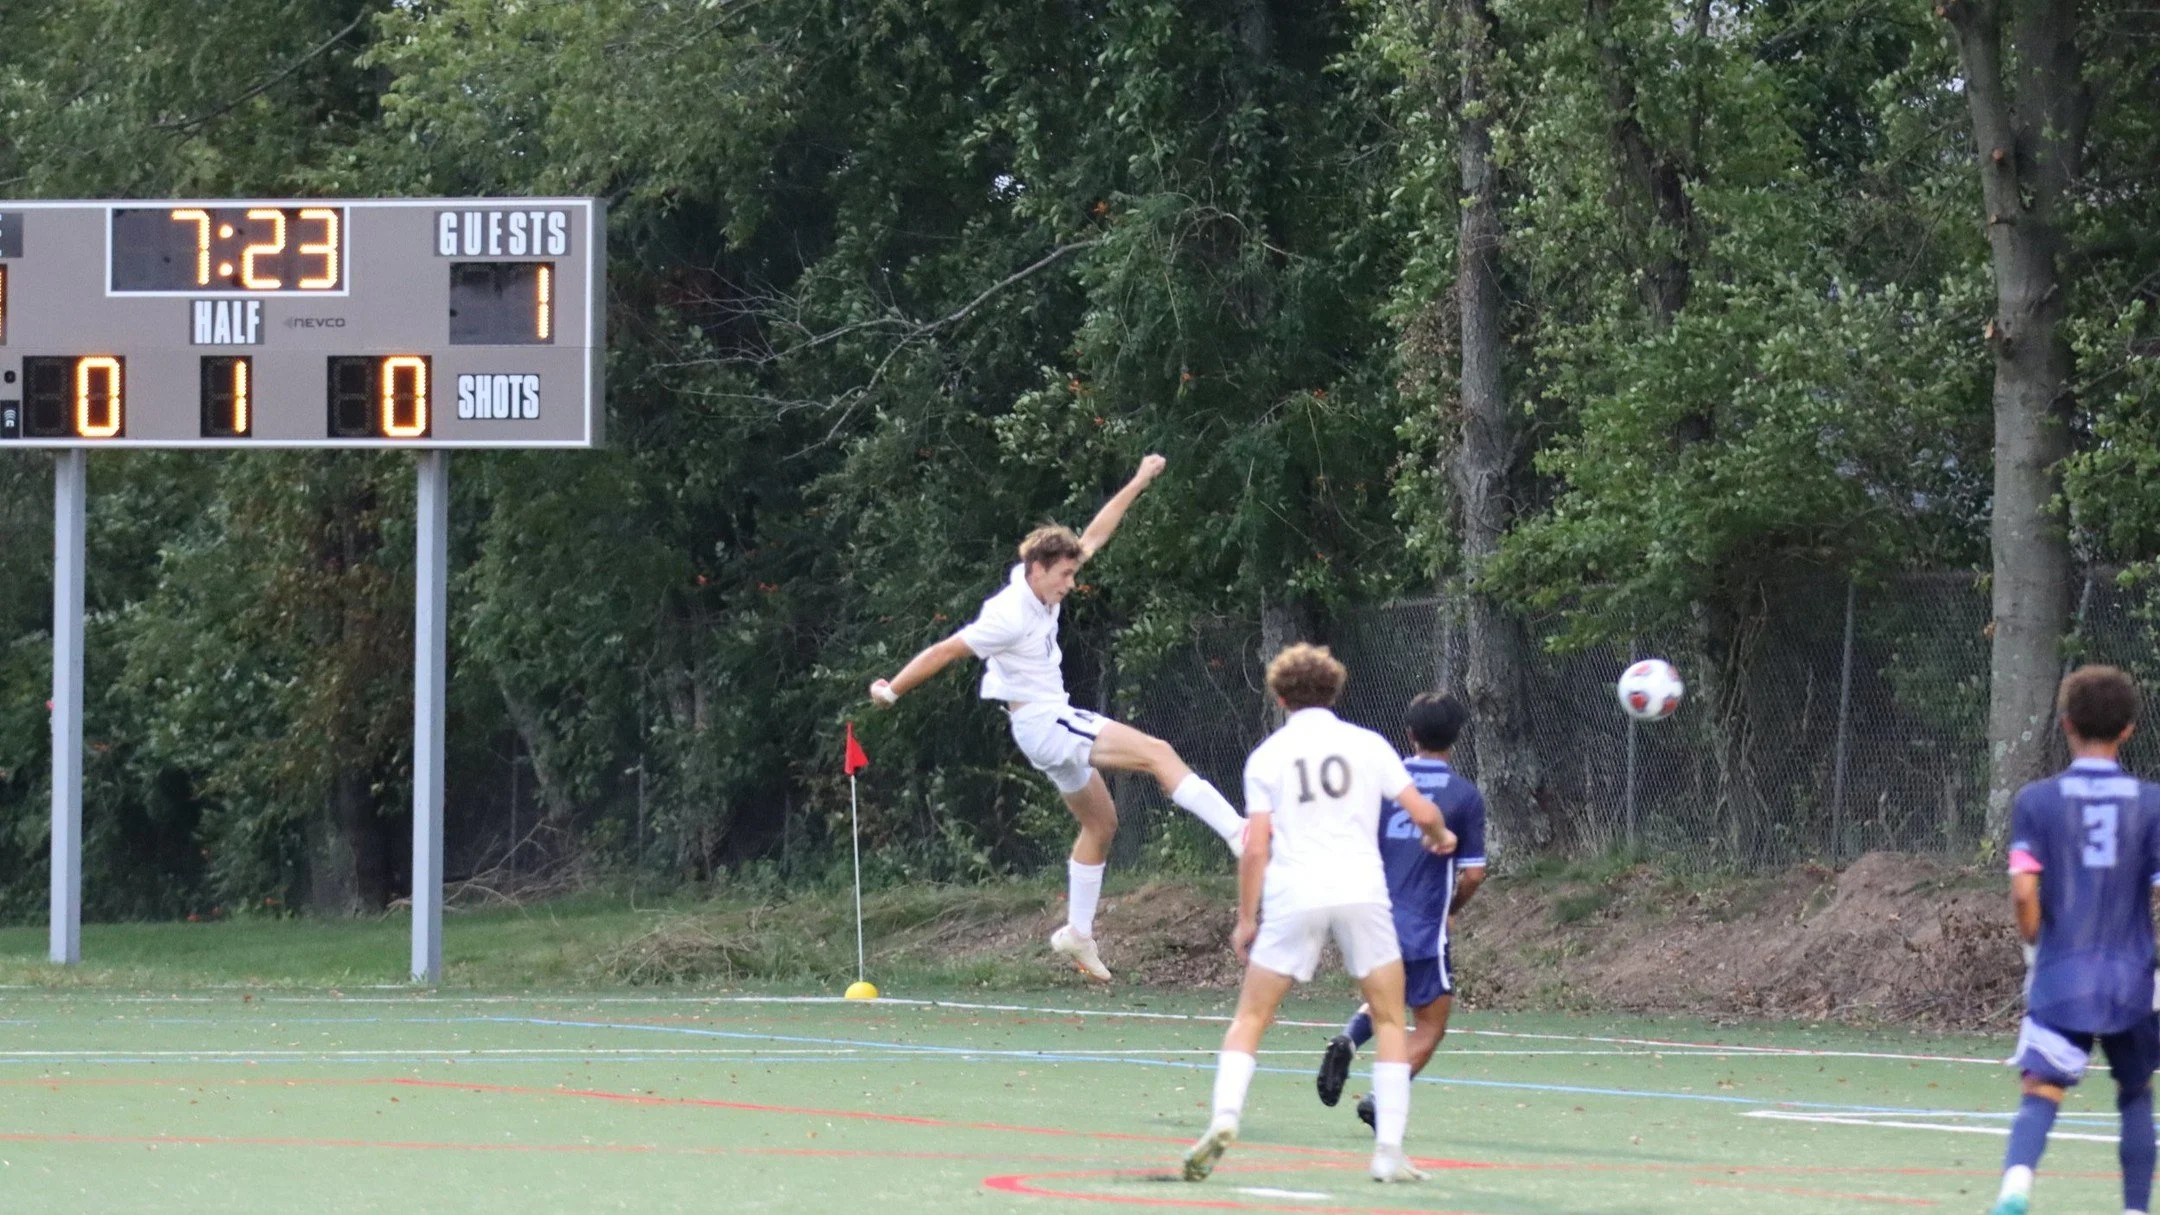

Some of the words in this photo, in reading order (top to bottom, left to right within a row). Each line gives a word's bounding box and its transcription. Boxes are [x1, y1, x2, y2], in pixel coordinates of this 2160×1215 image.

[172, 209, 339, 289] 7:23
[438, 211, 567, 256] GUESTS
[194, 300, 260, 344] HALF
[537, 265, 550, 339] 1
[77, 356, 121, 437] 0
[234, 360, 247, 433] 1
[382, 356, 427, 437] 0
[457, 374, 539, 419] SHOTS
[1293, 754, 1351, 803] 10
[2081, 803, 2118, 868] 3
